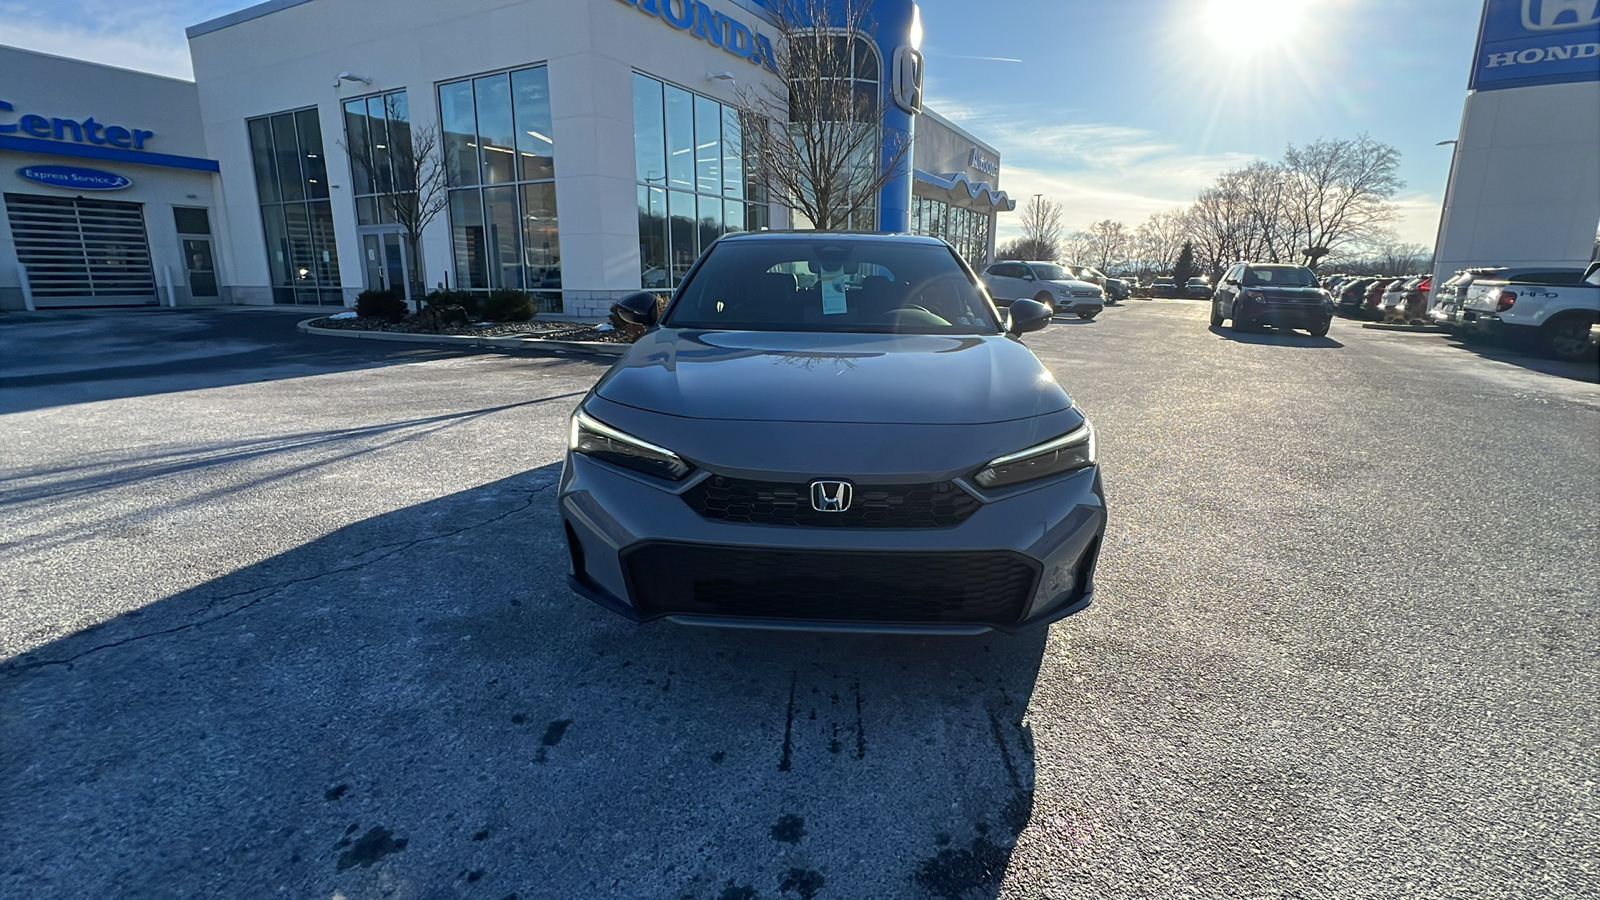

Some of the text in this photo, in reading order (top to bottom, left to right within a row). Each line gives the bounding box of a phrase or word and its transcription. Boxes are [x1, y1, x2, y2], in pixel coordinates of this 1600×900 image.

[25, 169, 110, 184] Express Service
[1520, 290, 1559, 298] HPD
